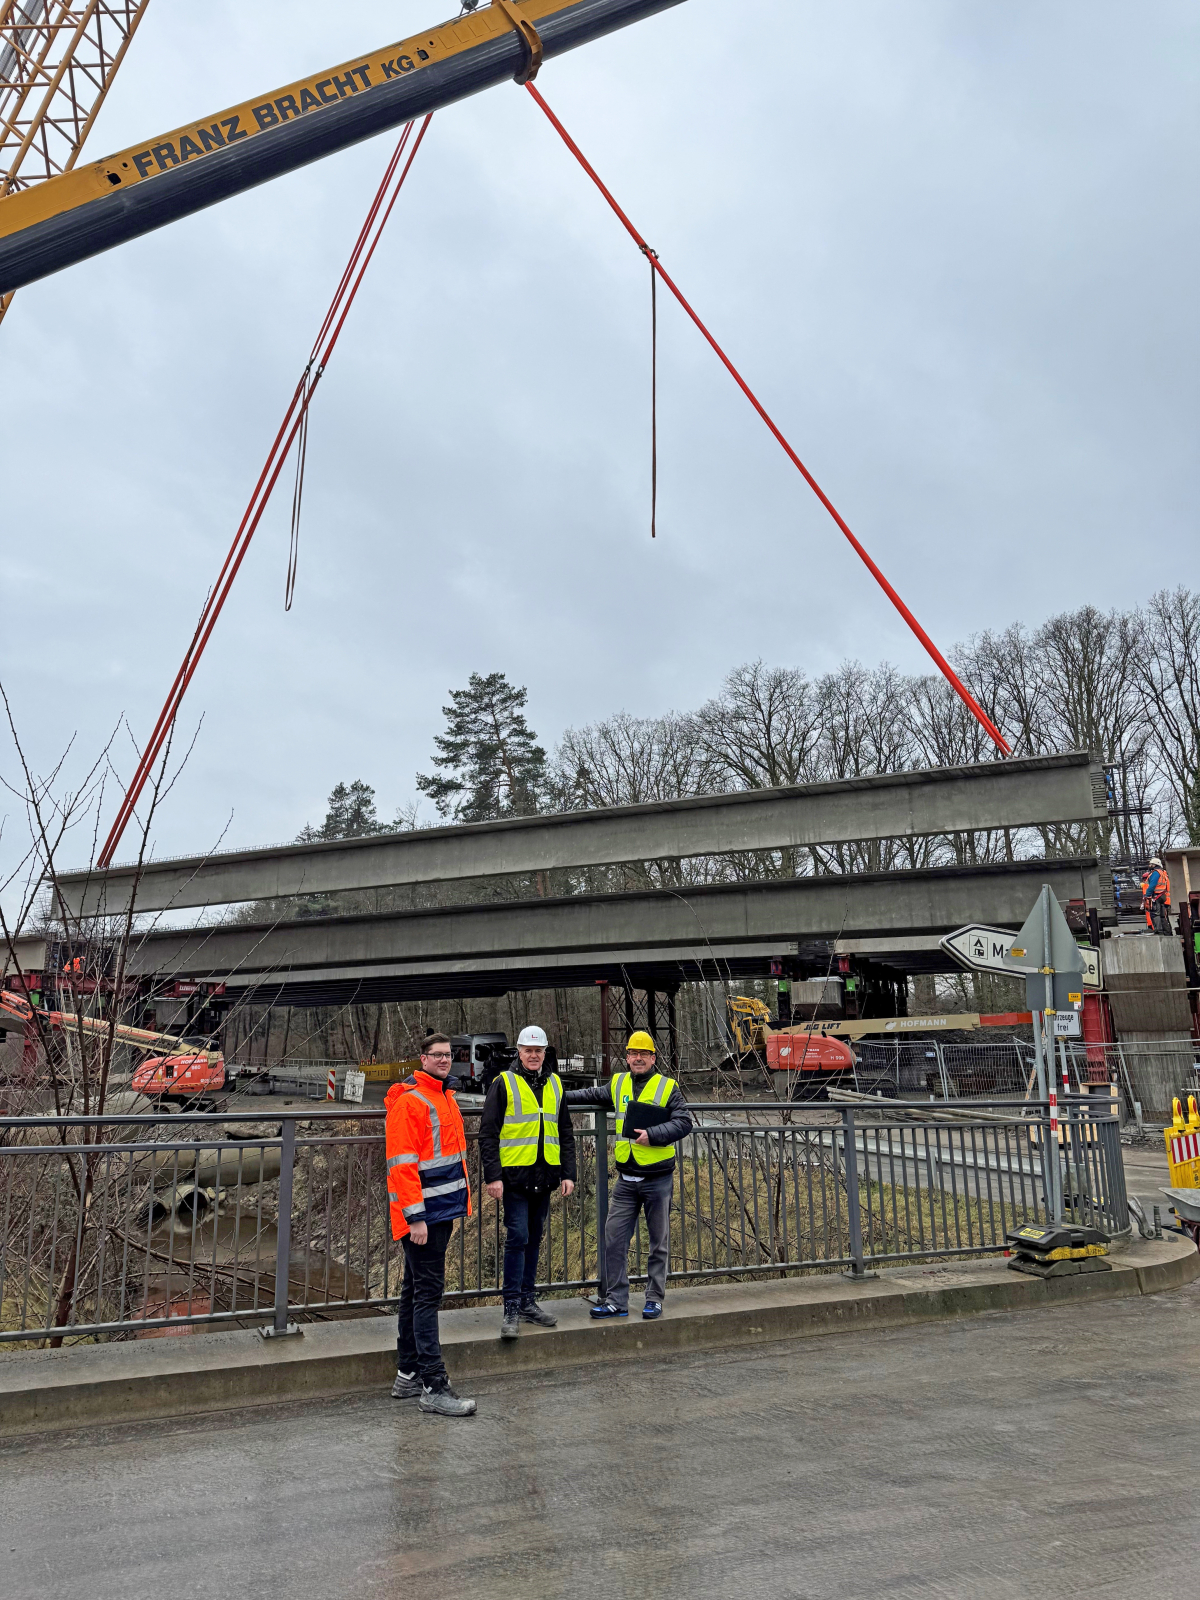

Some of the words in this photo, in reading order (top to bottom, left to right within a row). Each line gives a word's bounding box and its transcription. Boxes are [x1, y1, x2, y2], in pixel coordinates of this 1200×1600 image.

[132, 115, 248, 178] FRANZ
[251, 64, 371, 131] BRACHT
[380, 54, 416, 79] KG
[993, 942, 1006, 958] M
[1088, 964, 1096, 975] e
[821, 1022, 842, 1030] LIFT
[900, 1018, 947, 1028] HOFMANN
[1057, 1023, 1069, 1031] frei
